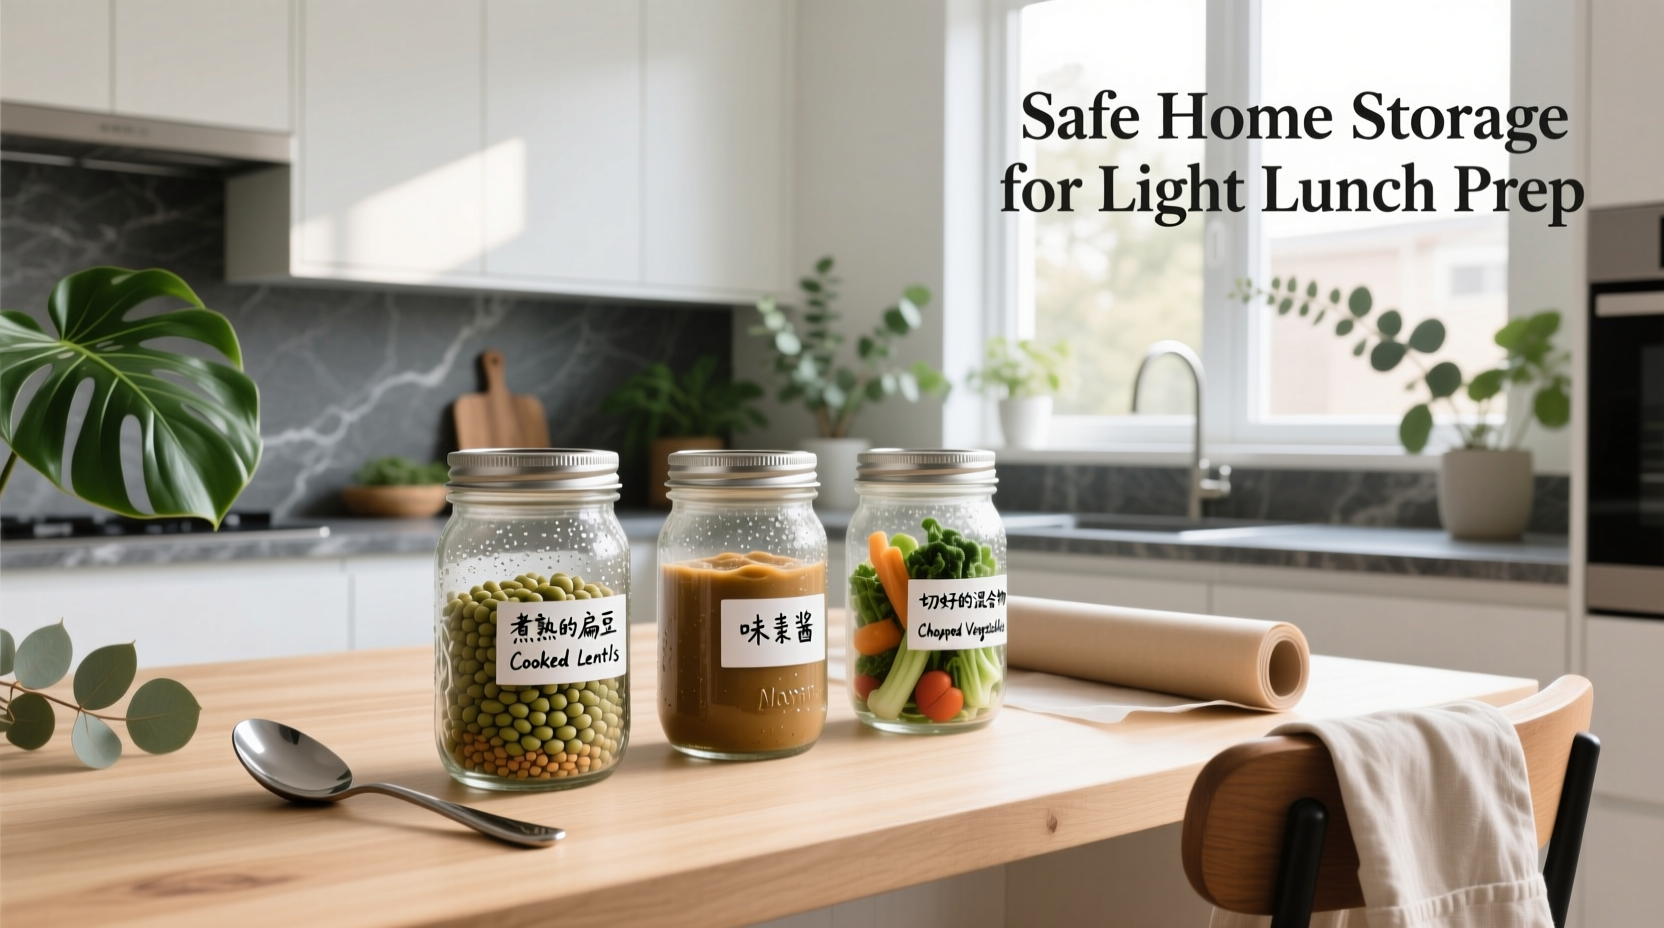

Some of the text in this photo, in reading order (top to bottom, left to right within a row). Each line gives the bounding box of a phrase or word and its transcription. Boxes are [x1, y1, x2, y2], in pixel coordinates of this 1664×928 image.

[510, 610, 617, 644] 煮熟的扁豆
[509, 648, 569, 671] Cooked
